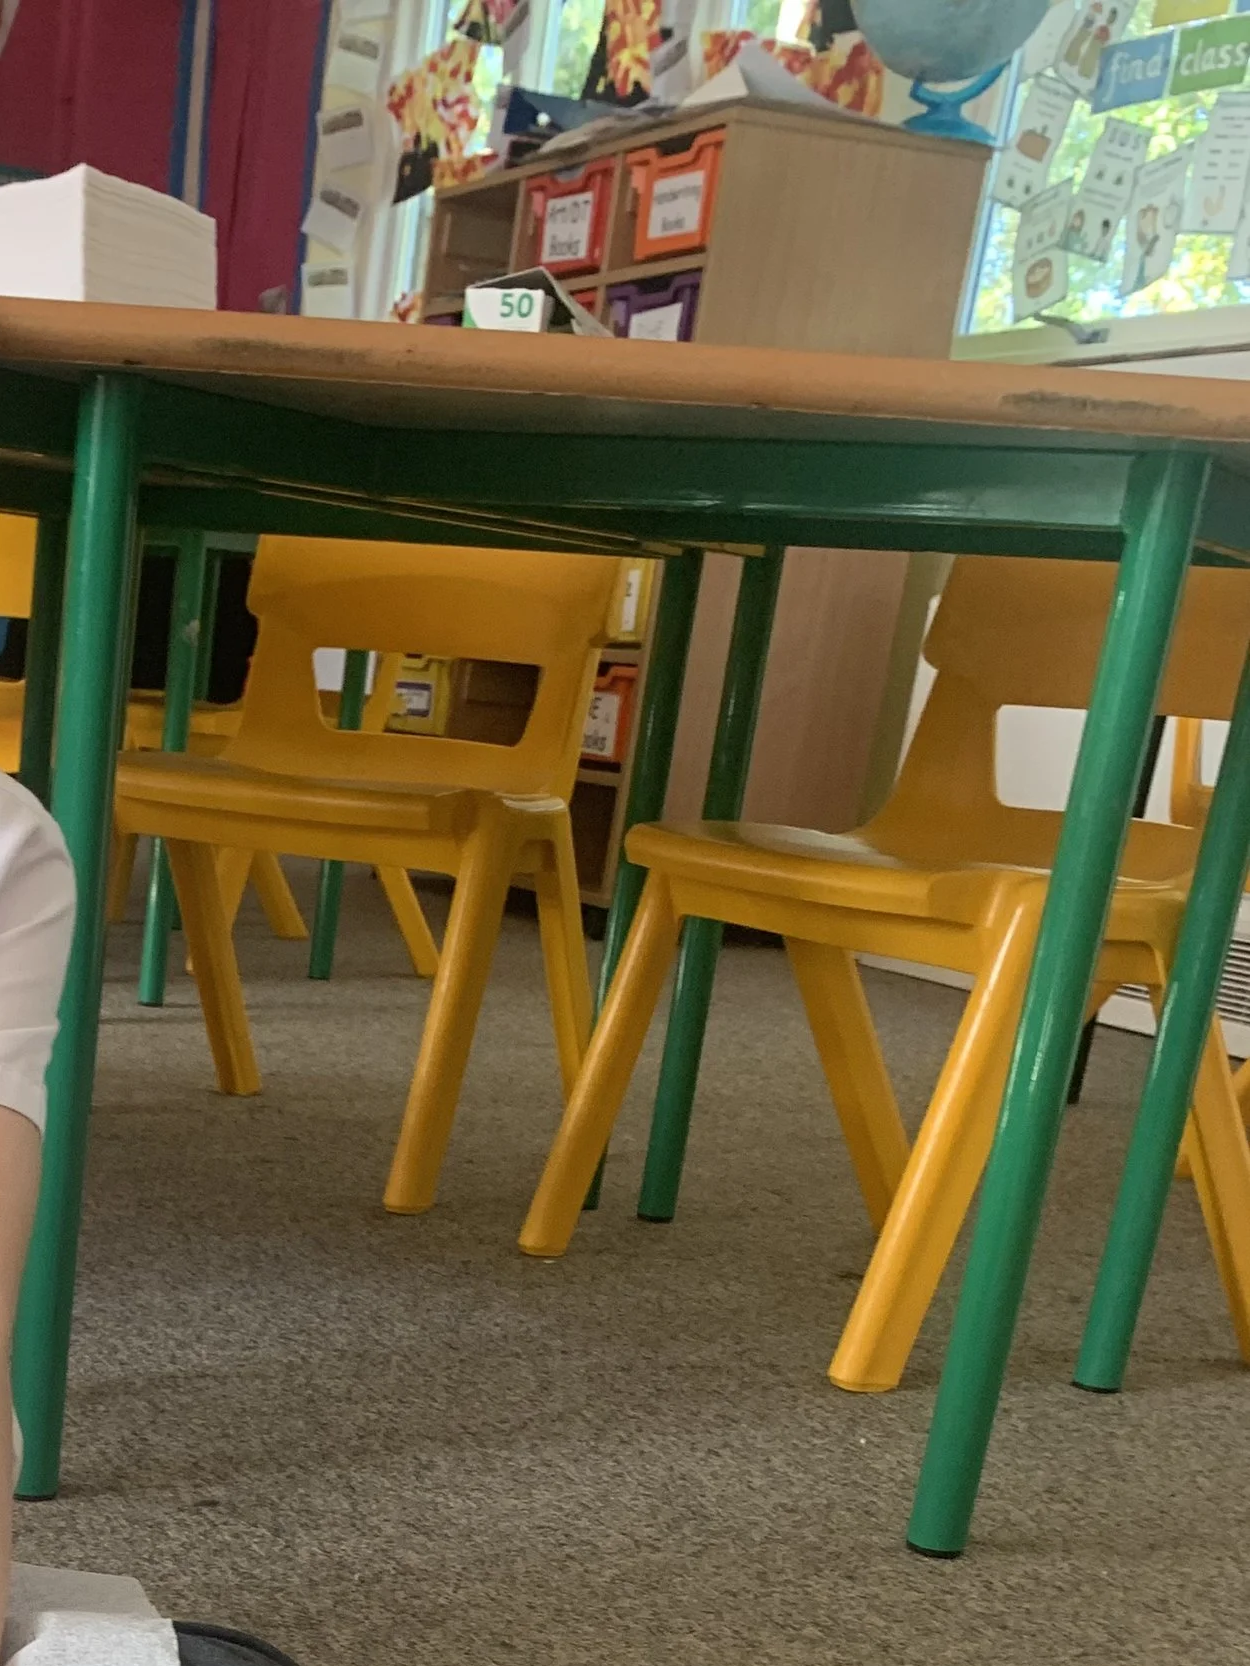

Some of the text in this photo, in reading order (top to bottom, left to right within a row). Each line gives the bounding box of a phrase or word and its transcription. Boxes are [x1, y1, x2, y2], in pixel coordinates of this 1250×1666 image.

[1101, 42, 1165, 102] find
[1179, 39, 1249, 77] class
[500, 292, 534, 318] 50
